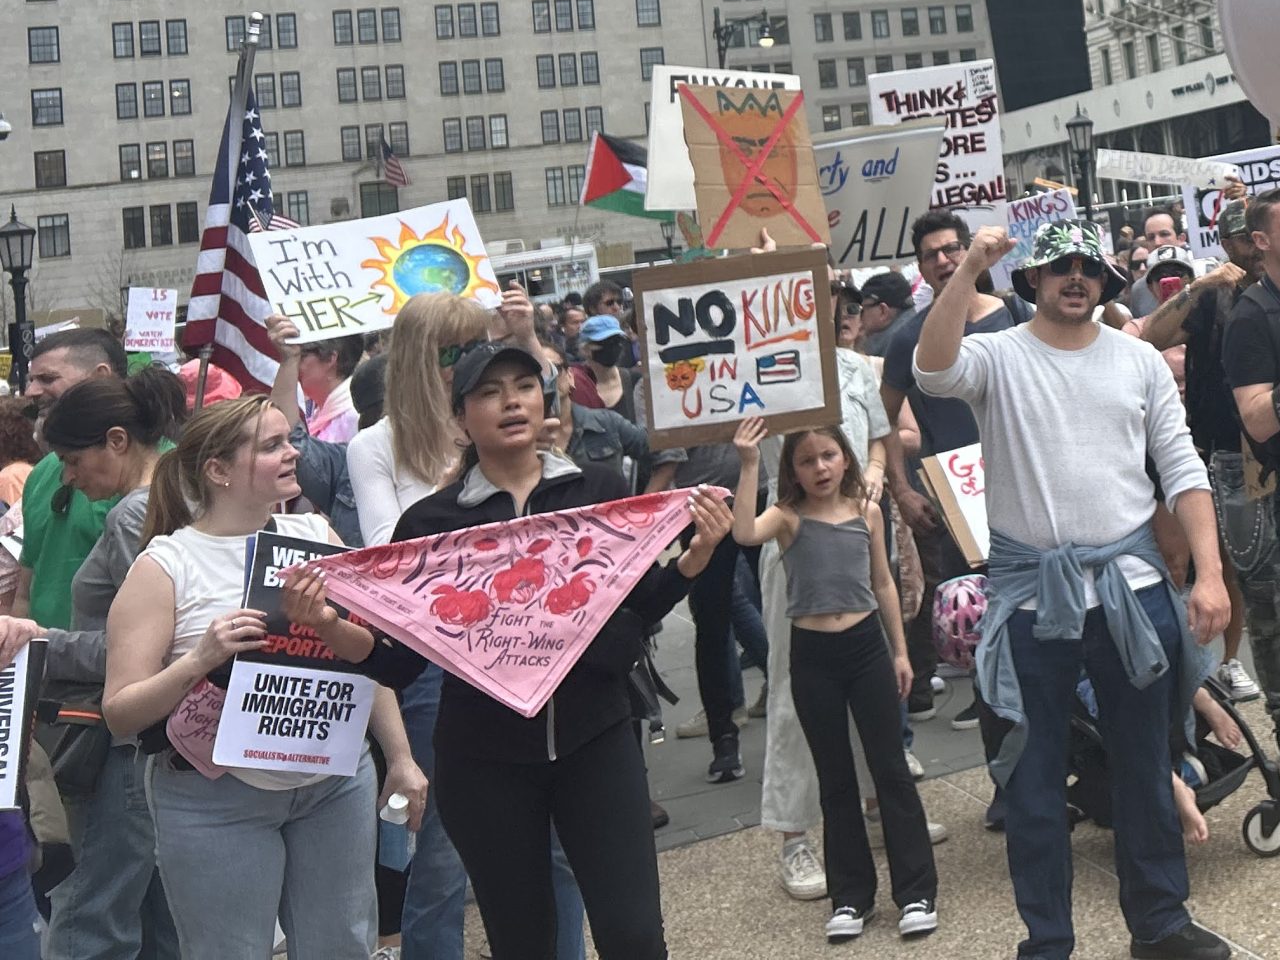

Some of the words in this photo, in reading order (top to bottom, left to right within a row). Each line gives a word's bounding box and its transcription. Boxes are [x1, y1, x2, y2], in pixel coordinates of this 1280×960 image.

[879, 86, 954, 115] THINK
[861, 146, 900, 177] and
[1011, 191, 1068, 222] KINGS
[838, 205, 916, 264] ALL
[269, 235, 337, 266] I'm
[268, 261, 352, 296] With
[151, 288, 168, 302] 15
[145, 311, 173, 321] VOTE
[278, 293, 364, 332] HER
[653, 289, 737, 346] NO
[709, 357, 738, 382] IN
[681, 381, 766, 419] USA
[540, 620, 555, 629] THE
[253, 673, 313, 698] UNITE
[315, 679, 354, 702] FOR
[241, 692, 357, 722] IMMIGRANT
[257, 715, 331, 741] RIGHTS
